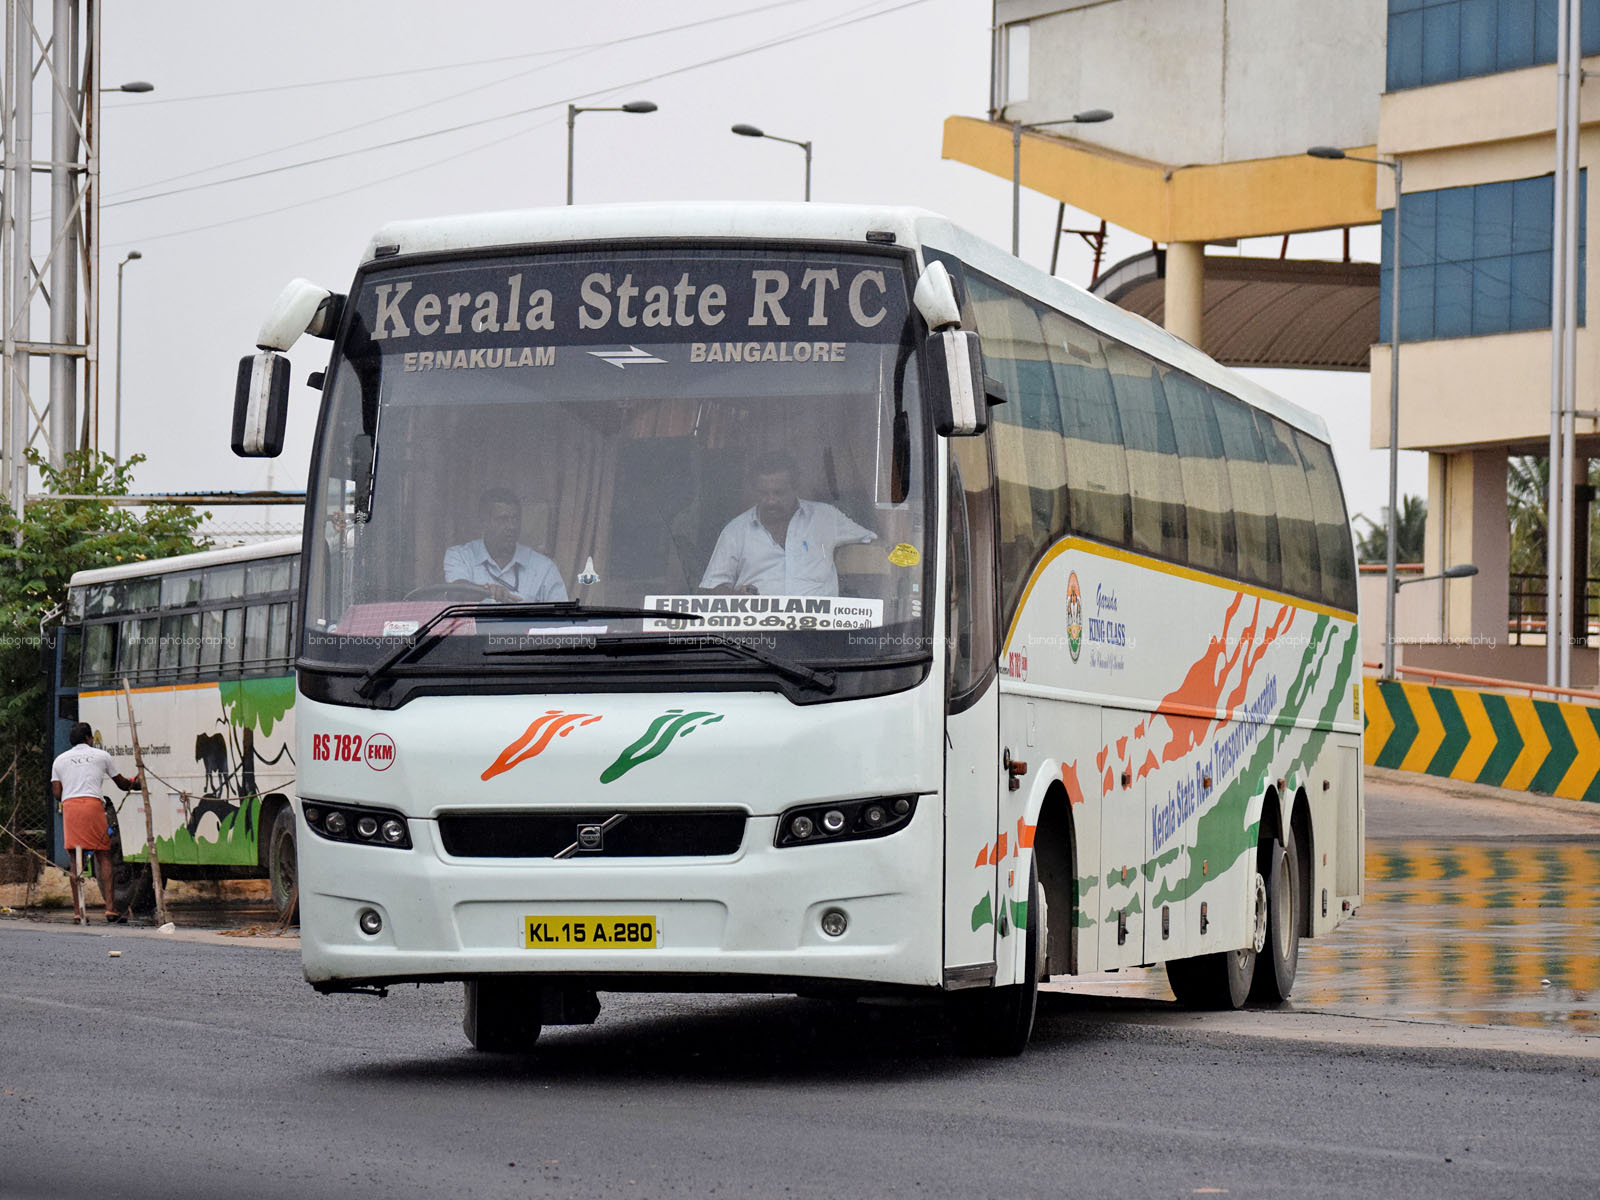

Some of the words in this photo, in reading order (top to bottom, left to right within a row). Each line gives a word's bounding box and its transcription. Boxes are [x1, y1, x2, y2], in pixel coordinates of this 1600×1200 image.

[370, 273, 555, 341] Kerala
[579, 271, 726, 330] State
[748, 268, 888, 328] RTC
[404, 346, 556, 372] ERNAKULAM
[690, 342, 846, 363] BANGALORE
[655, 598, 831, 614] ERNAKULAM
[833, 607, 873, 617] (KOCHI)
[1088, 618, 1105, 643] KING
[1107, 621, 1126, 647] CLASS
[313, 733, 331, 761] RS
[333, 734, 363, 762] 782
[367, 744, 393, 760] EKM
[1152, 790, 1176, 854] Kerala
[1176, 771, 1195, 828] State
[1196, 747, 1213, 808] Road
[1214, 720, 1245, 785] Transport
[1243, 672, 1278, 746] Corporation
